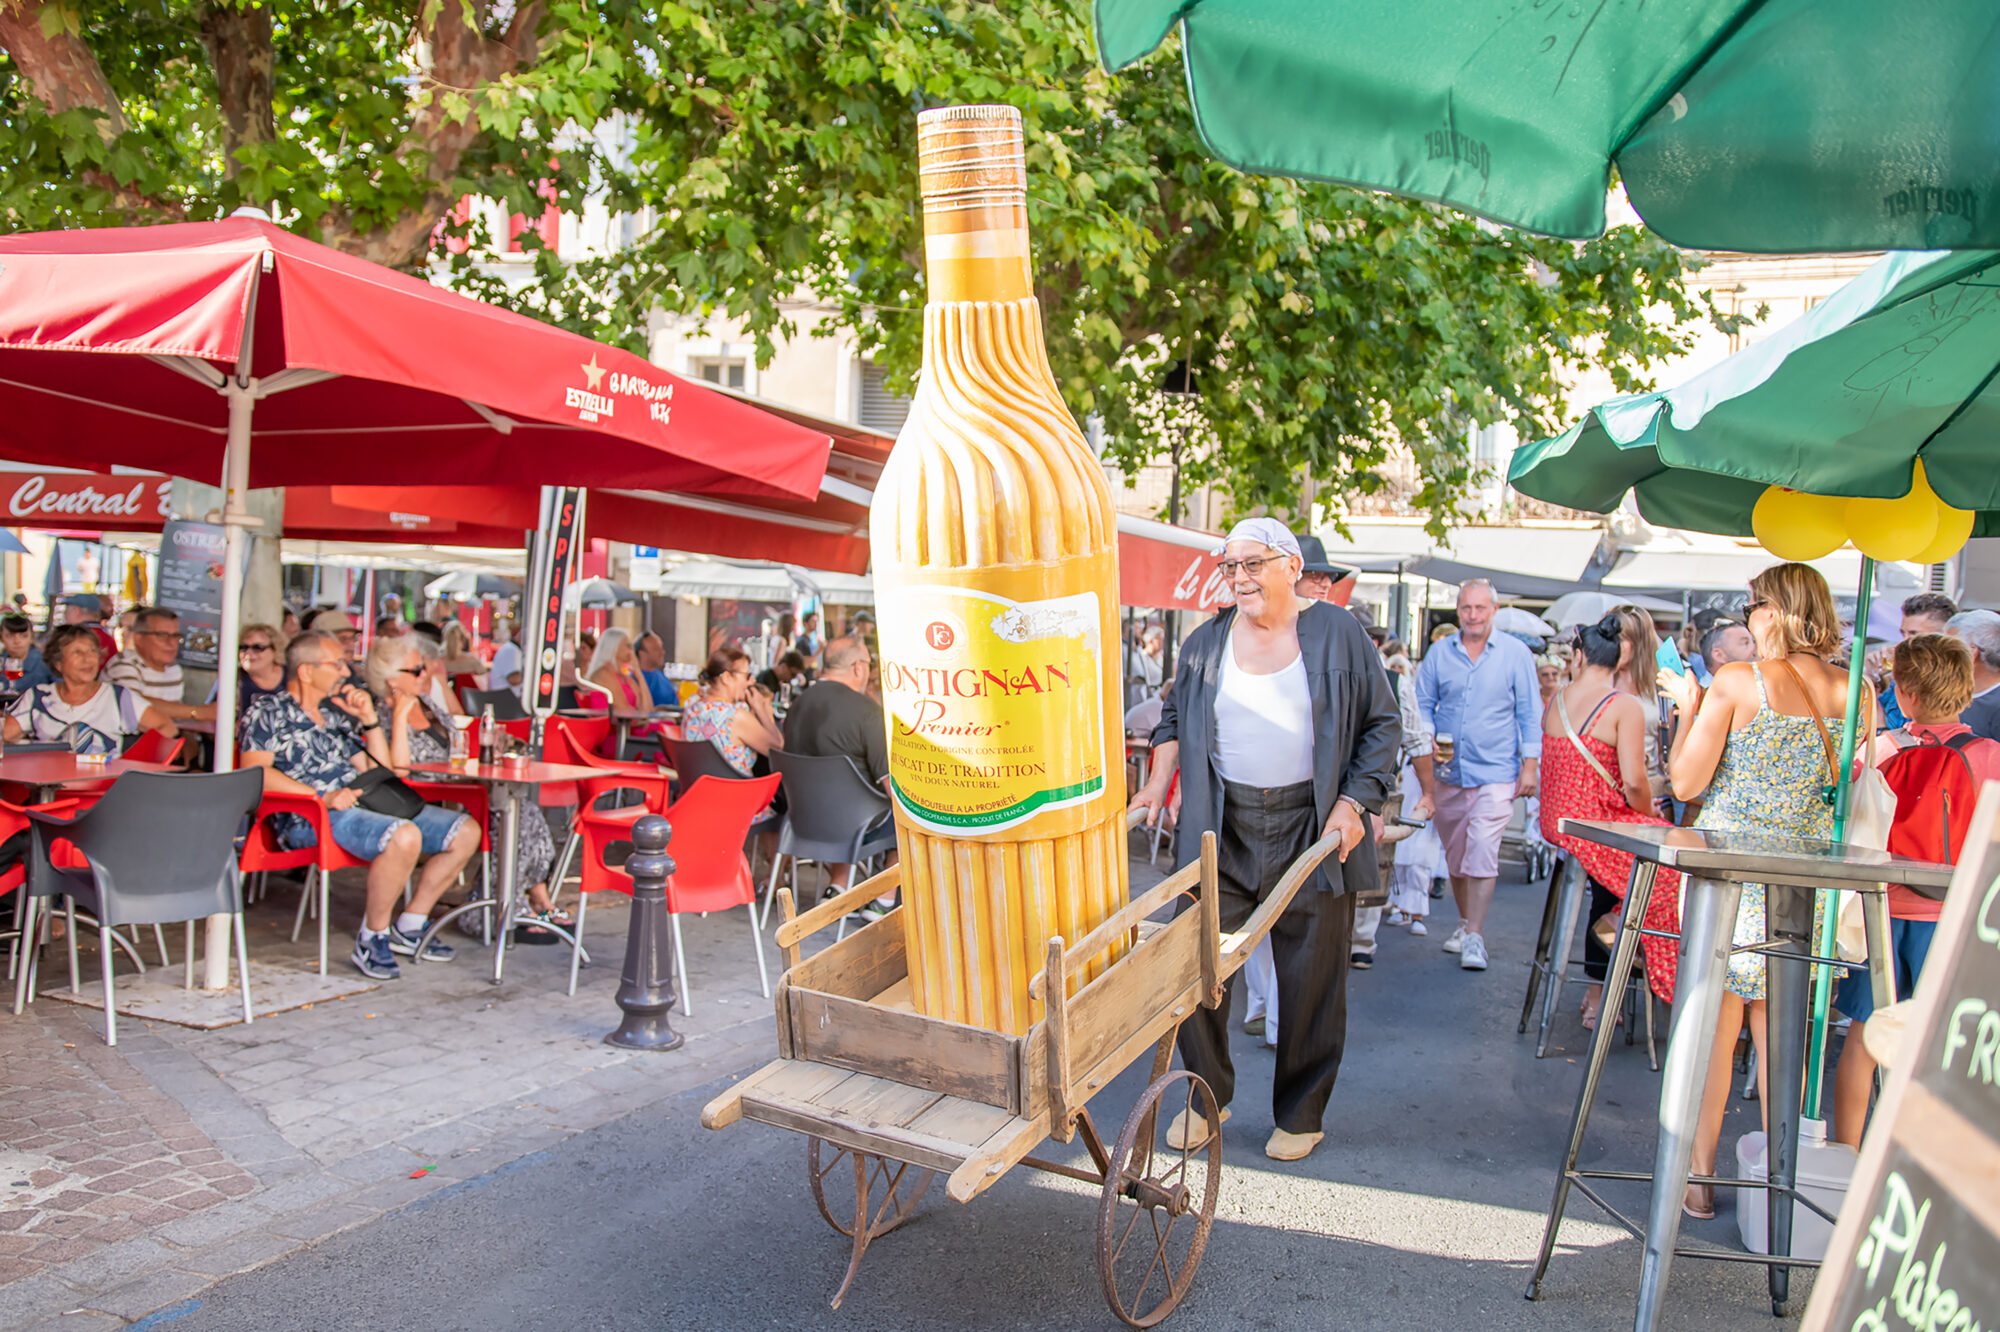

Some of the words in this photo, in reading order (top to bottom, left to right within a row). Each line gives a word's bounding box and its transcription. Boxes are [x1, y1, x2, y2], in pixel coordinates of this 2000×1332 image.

[565, 386, 615, 417] ESTRELLA
[9, 475, 145, 517] Central
[1174, 556, 1200, 600] Le
[880, 656, 1071, 698] RONTIGNAN
[900, 697, 1002, 737] Premier
[910, 773, 924, 784] VIN
[924, 775, 951, 788] DOUX
[951, 779, 1001, 790] NATUREL
[927, 762, 948, 776] DE
[950, 761, 1047, 778] TRADITION
[910, 792, 921, 803] EN
[920, 797, 955, 813] BOUTEILLE
[956, 805, 963, 813] A
[964, 805, 975, 813] LA
[994, 813, 1004, 821] DE
[1003, 804, 1027, 818] FRANCE
[1941, 998, 2000, 1088] FR
